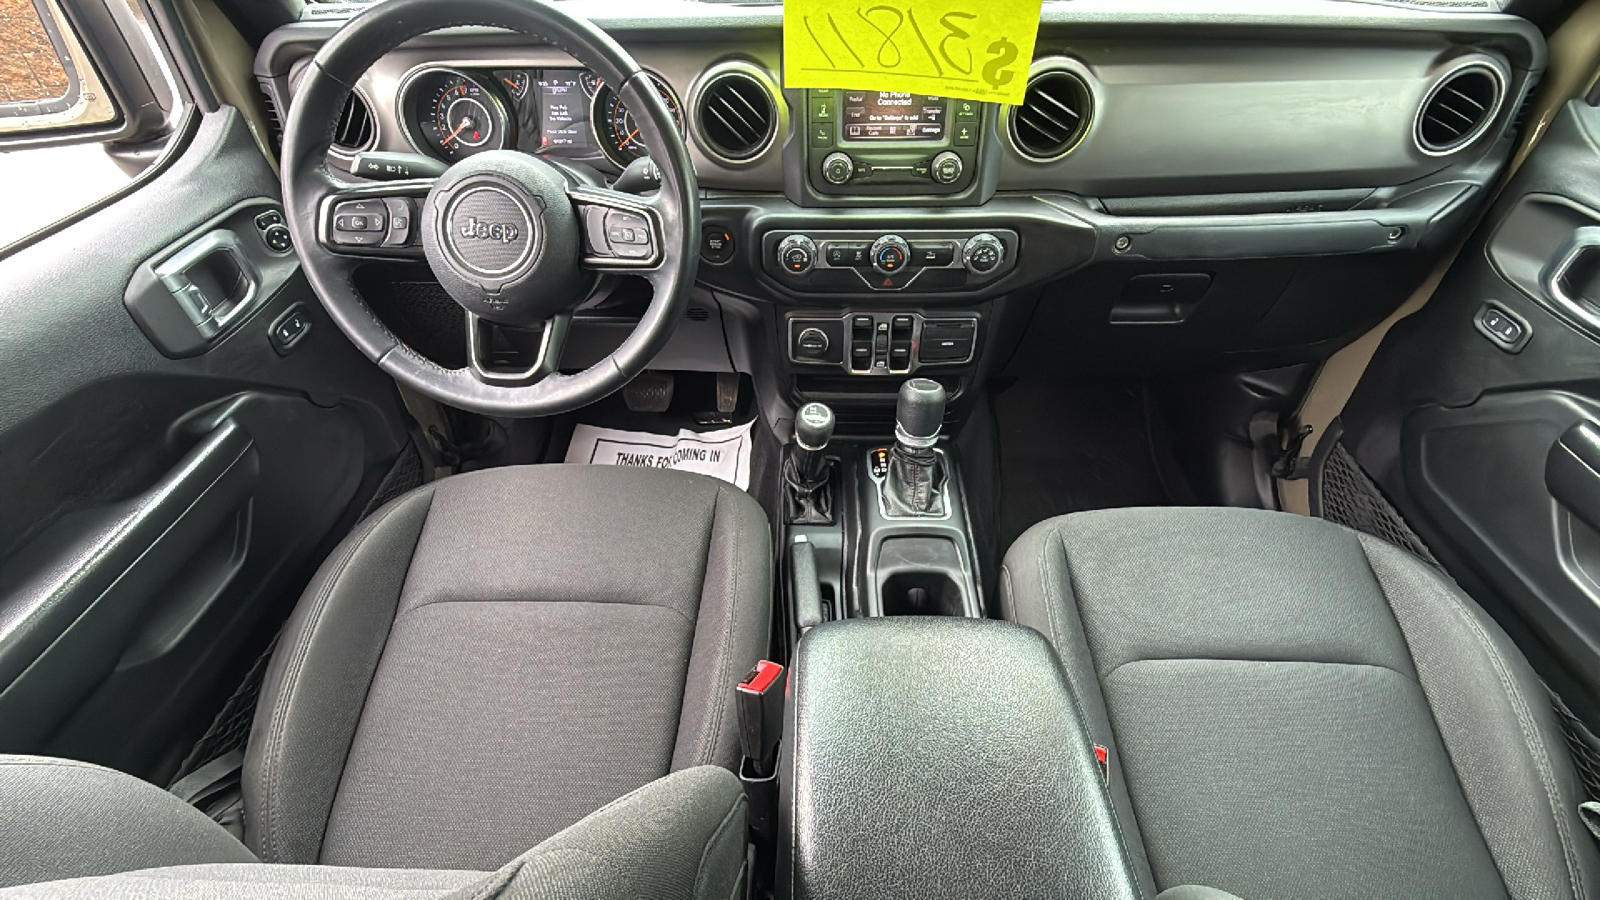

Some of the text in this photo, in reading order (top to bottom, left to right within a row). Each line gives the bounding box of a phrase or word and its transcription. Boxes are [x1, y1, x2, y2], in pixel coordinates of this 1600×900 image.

[461, 216, 518, 244] Jeep
[616, 452, 654, 468] THANKS
[672, 447, 707, 466] COMING
[709, 449, 721, 463] IN
